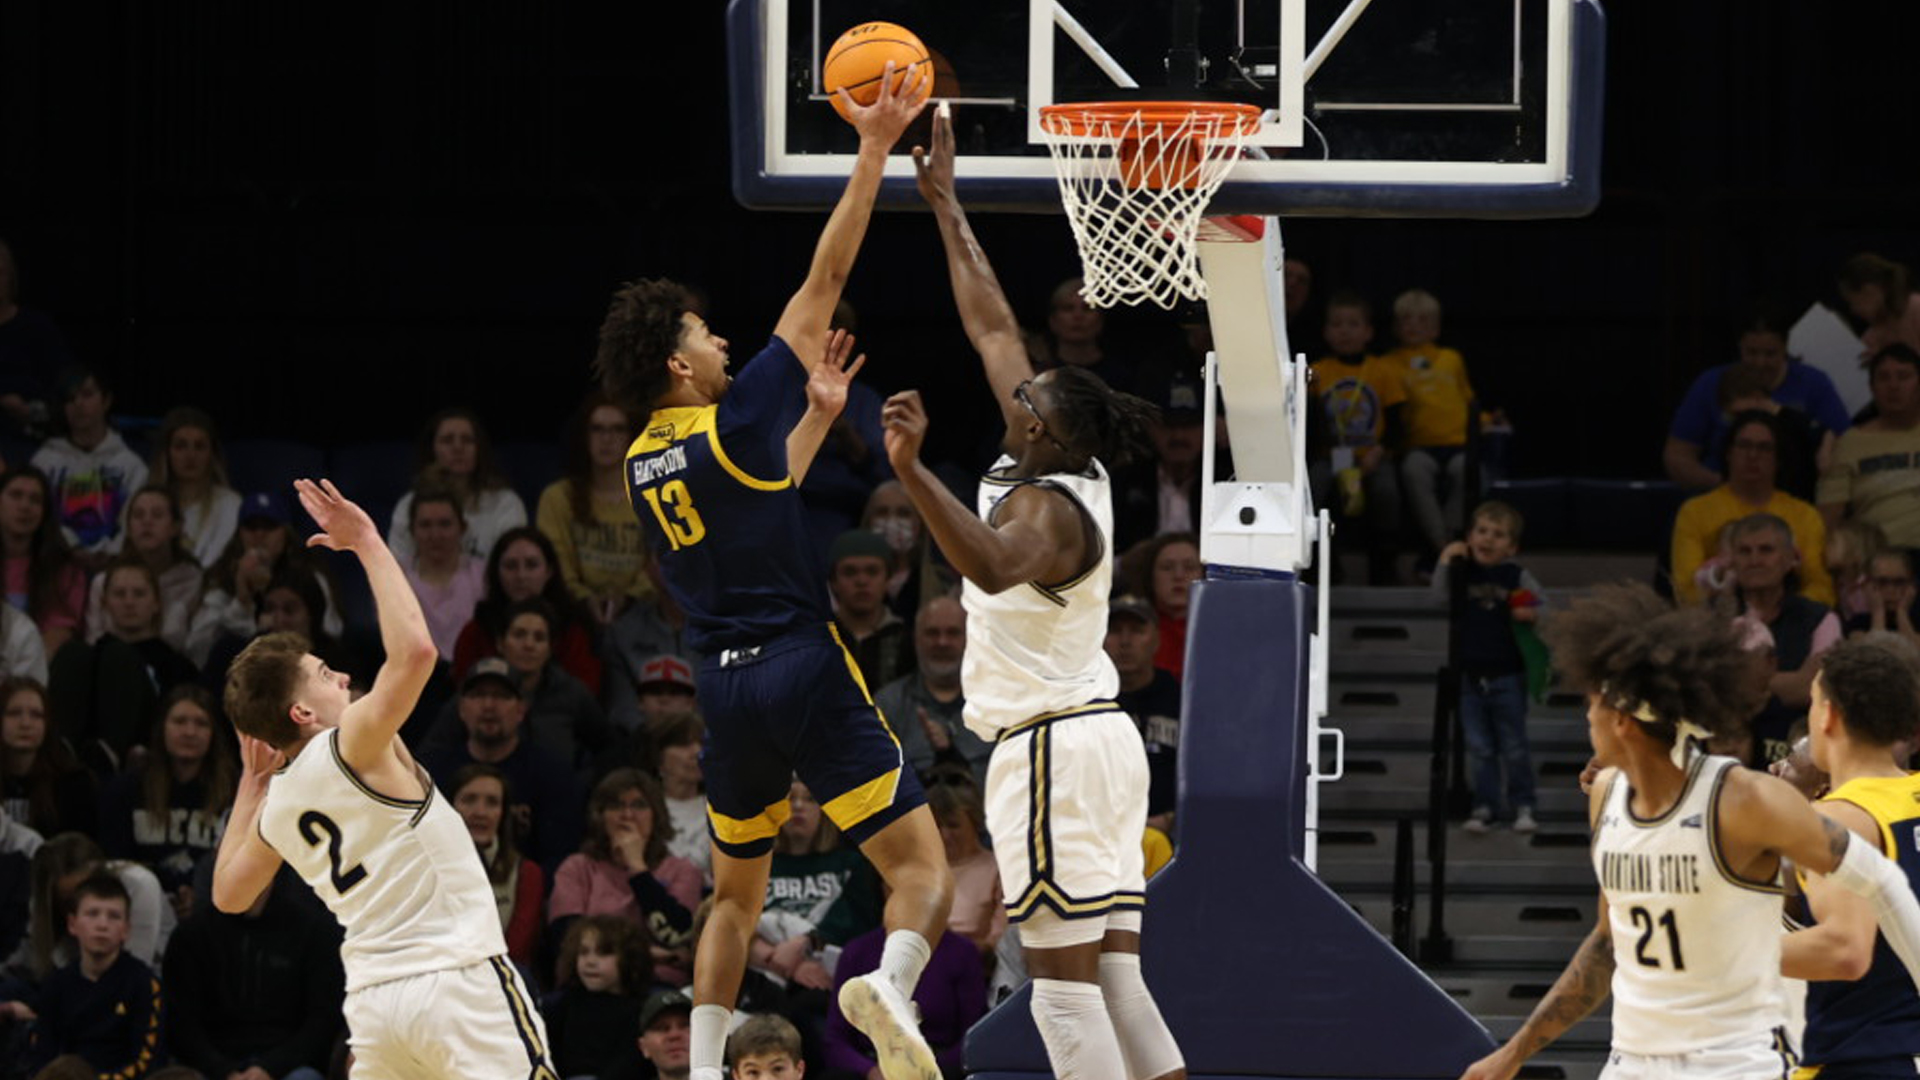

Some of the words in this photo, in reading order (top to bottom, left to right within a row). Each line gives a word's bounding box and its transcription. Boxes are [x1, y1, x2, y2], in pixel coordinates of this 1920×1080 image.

[641, 479, 706, 551] 13
[299, 811, 367, 894] 2
[1602, 850, 1652, 892] MONTANA
[1658, 853, 1700, 893] STATE
[1630, 906, 1684, 971] 21
